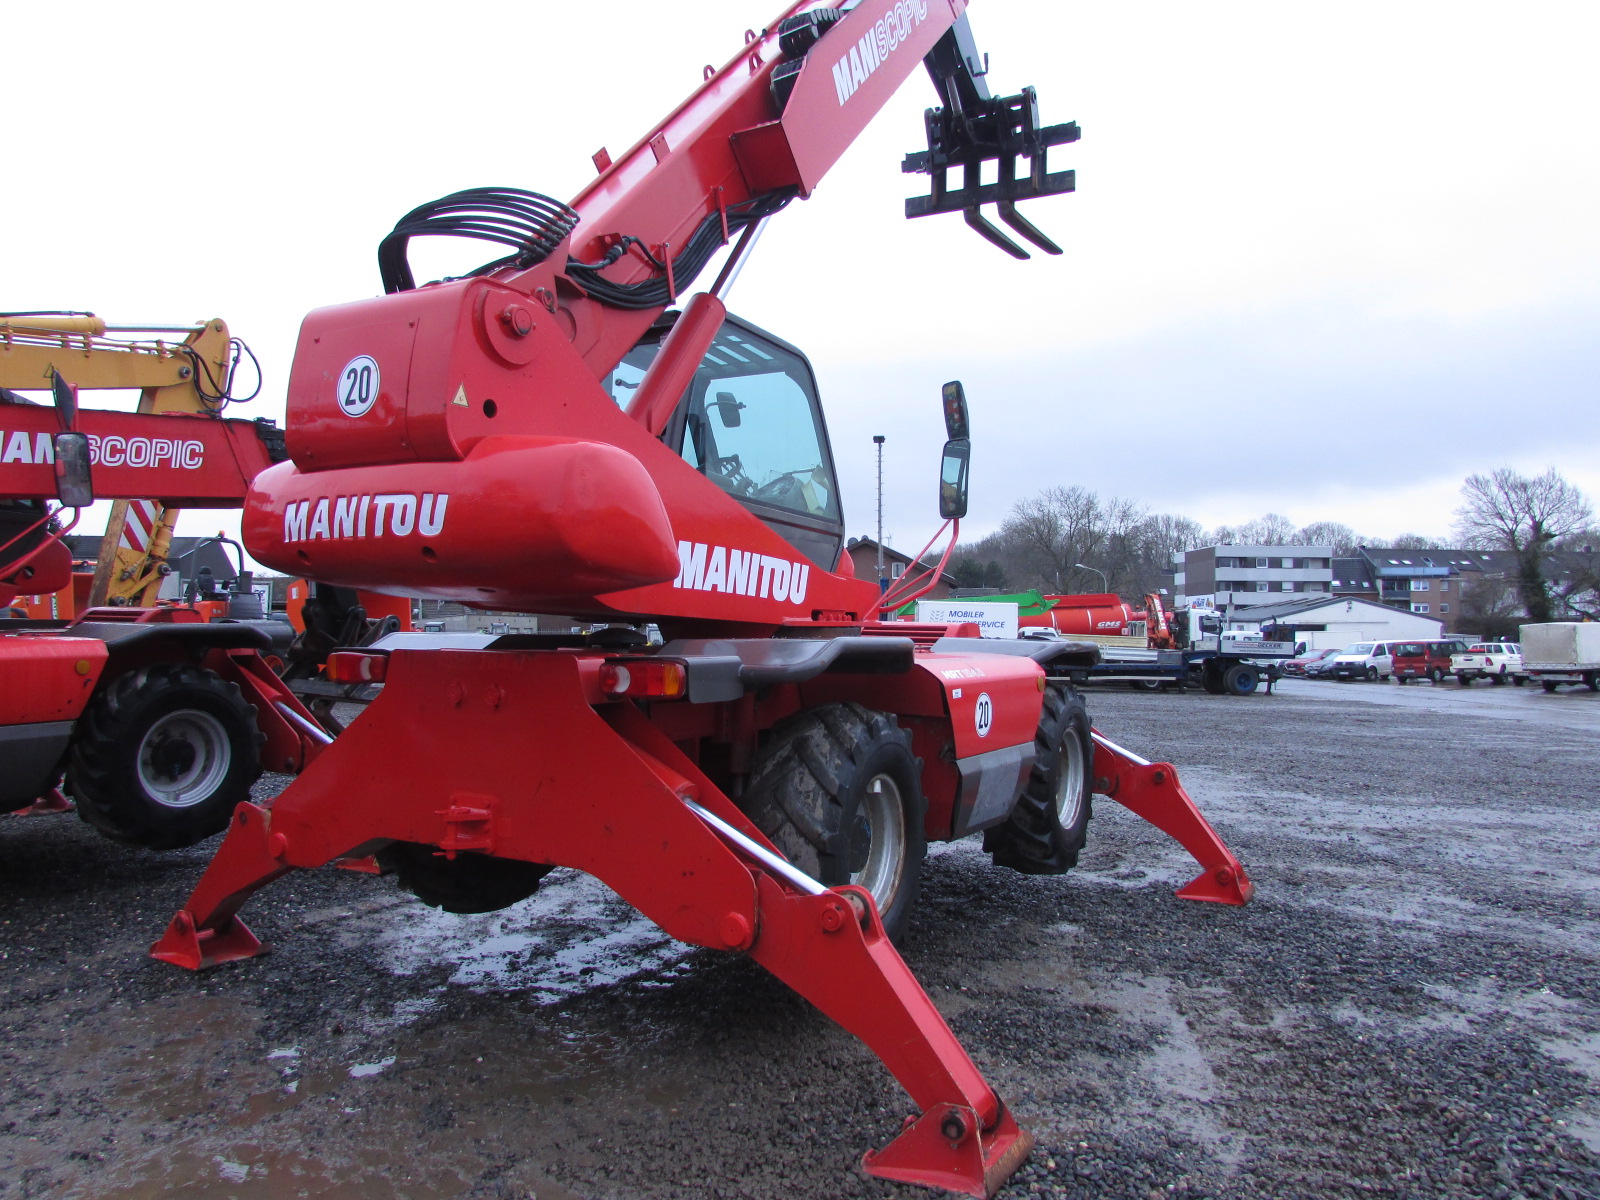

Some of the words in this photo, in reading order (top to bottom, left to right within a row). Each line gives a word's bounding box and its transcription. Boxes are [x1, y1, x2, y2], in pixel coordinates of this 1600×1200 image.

[344, 365, 372, 406] 20
[284, 493, 449, 543] MANITOU
[673, 540, 810, 605] MANITOU
[948, 610, 985, 619] MOBILER
[978, 700, 989, 729] 20
